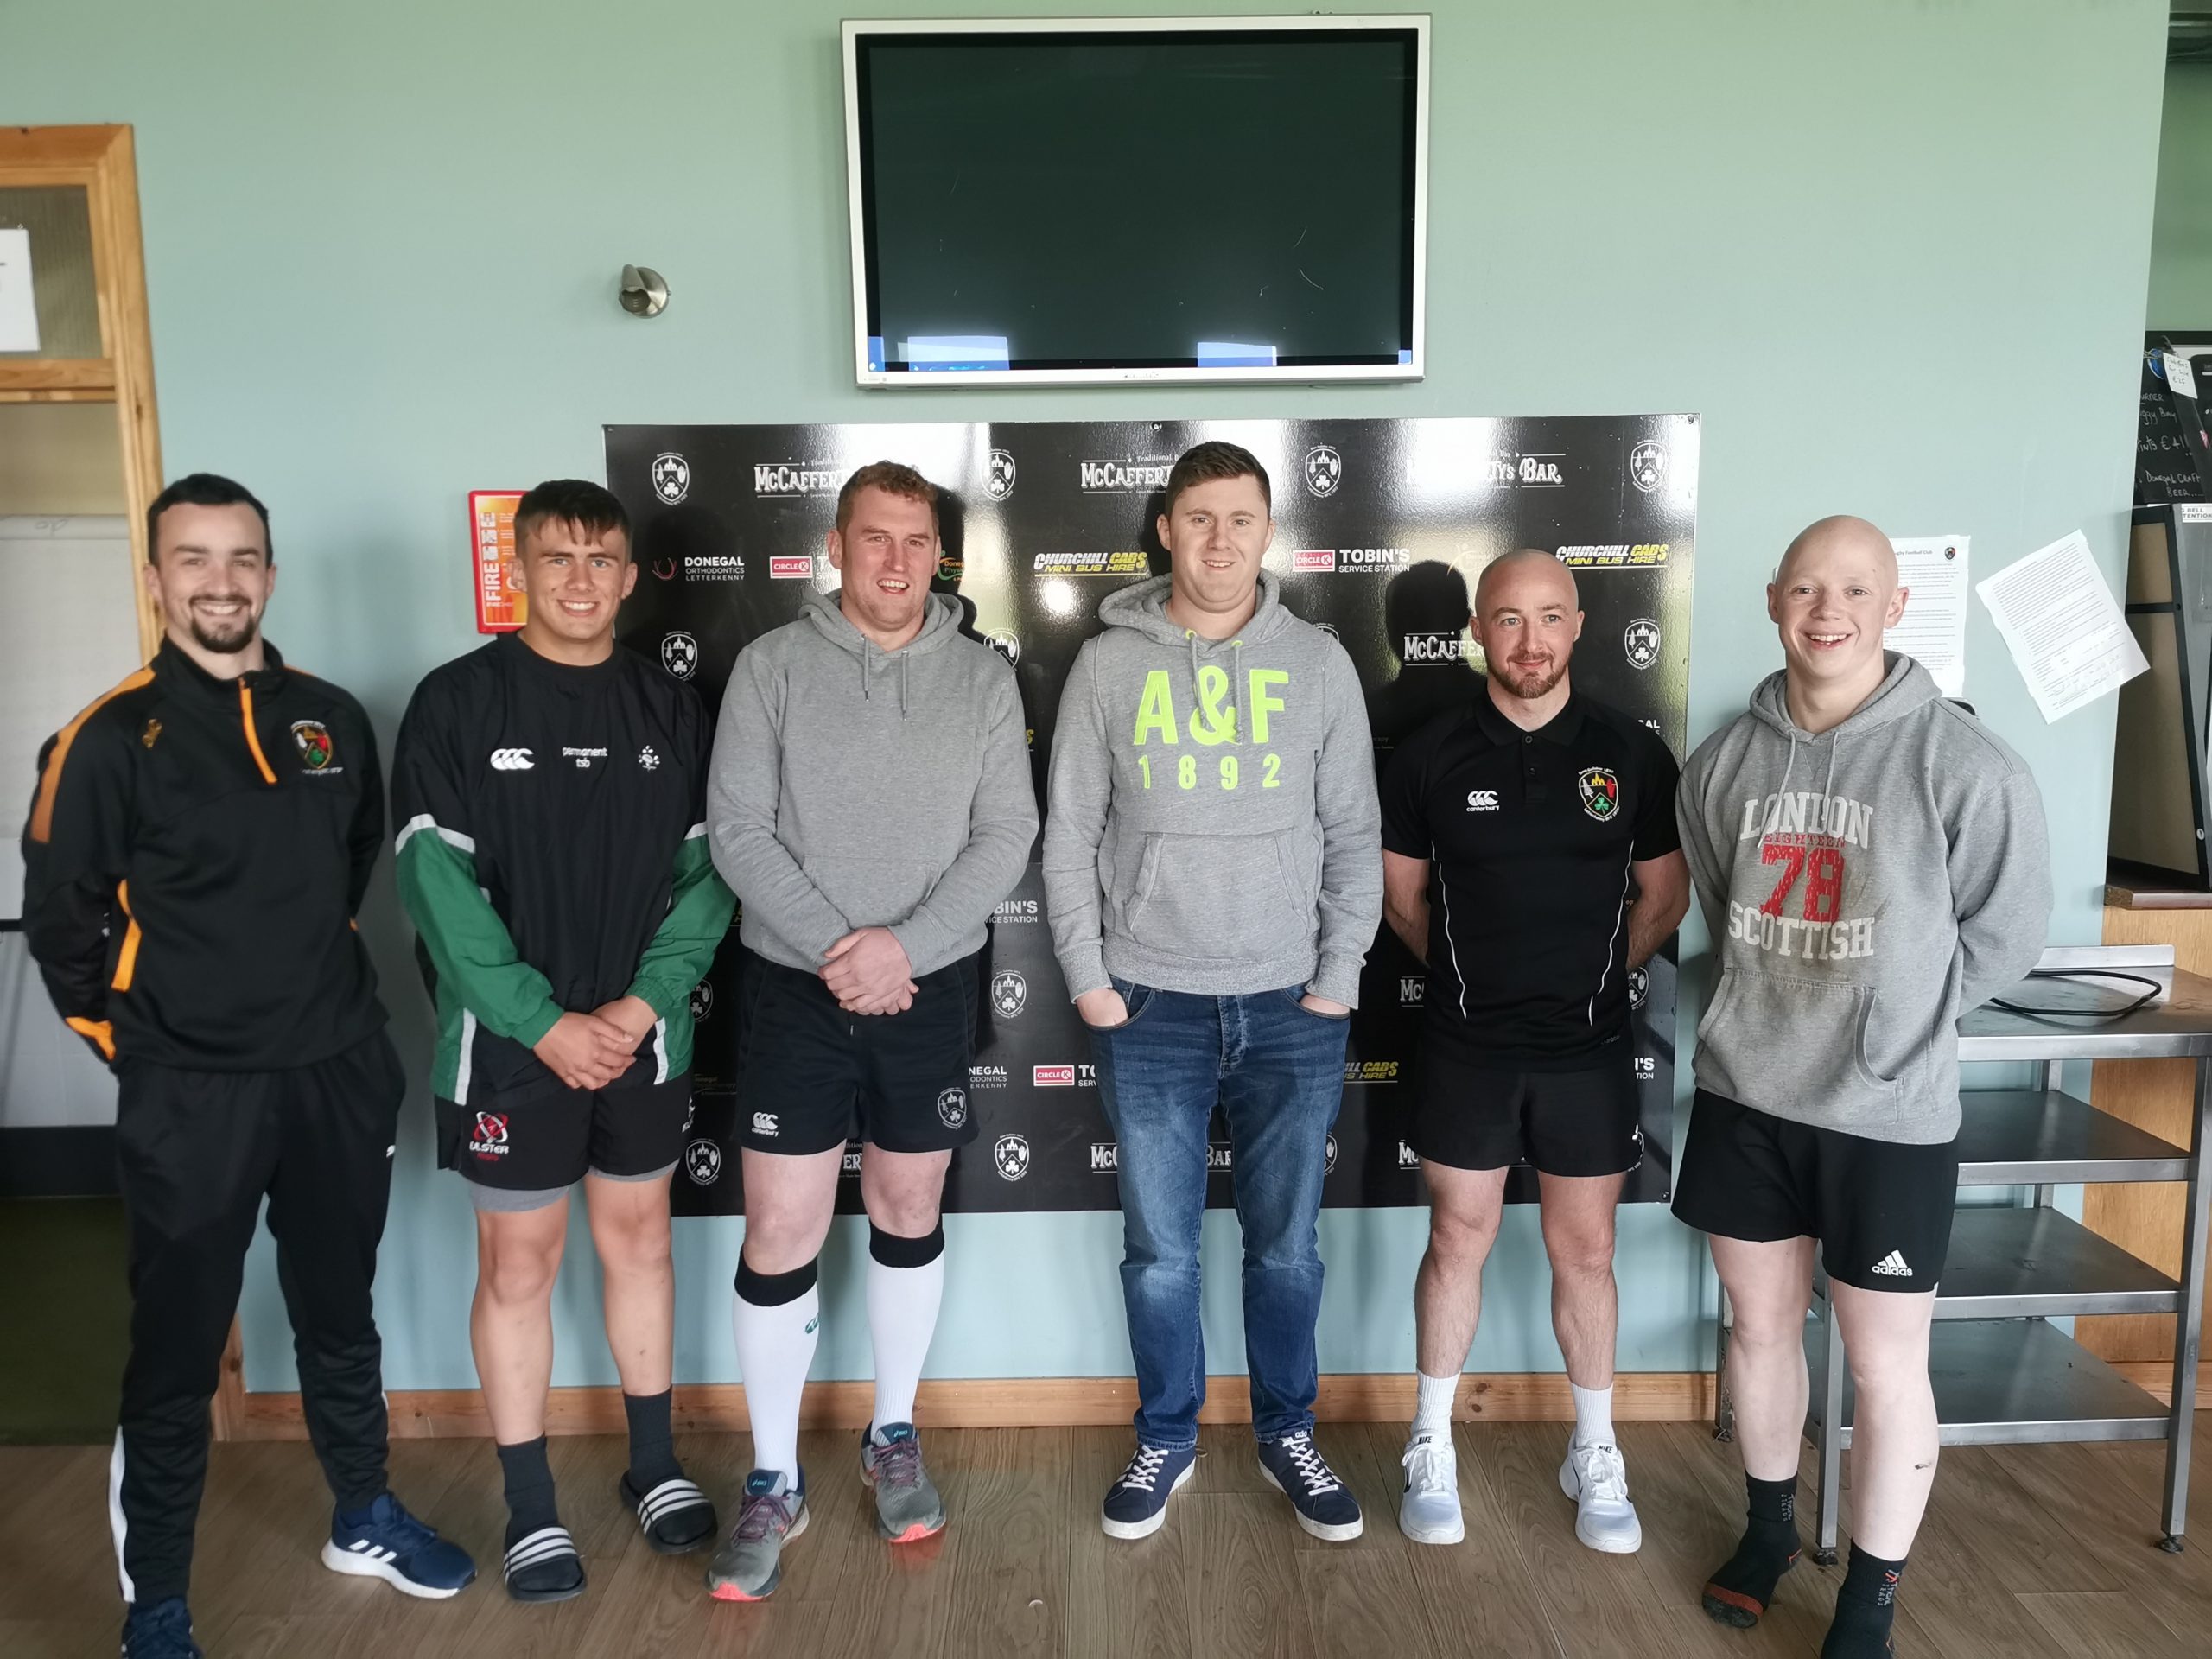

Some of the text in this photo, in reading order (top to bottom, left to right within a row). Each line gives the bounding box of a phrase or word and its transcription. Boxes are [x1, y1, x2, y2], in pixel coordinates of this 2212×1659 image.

[1081, 462, 1175, 489] McCAFFERT
[1339, 549, 1410, 563] TOBIN'S
[1556, 544, 1669, 560] CHURCHILL CABS
[684, 556, 745, 567] DONEGAL
[1034, 552, 1147, 569] CHURCHILL CABS
[1106, 563, 1135, 572] HIRE
[484, 563, 501, 601] FIRE
[1404, 636, 1484, 661] McCAFFER
[1466, 804, 1500, 812] canterbury
[1739, 791, 1873, 849] LONDON
[1759, 843, 1845, 923] 78
[994, 899, 1038, 914] BIN'S
[1728, 899, 1875, 960] SCOTTISH
[969, 1066, 1007, 1076] NEGAL
[1363, 1061, 1399, 1077] CABS
[469, 1141, 509, 1154] ULSTER
[1872, 1265, 1913, 1277] adidas
